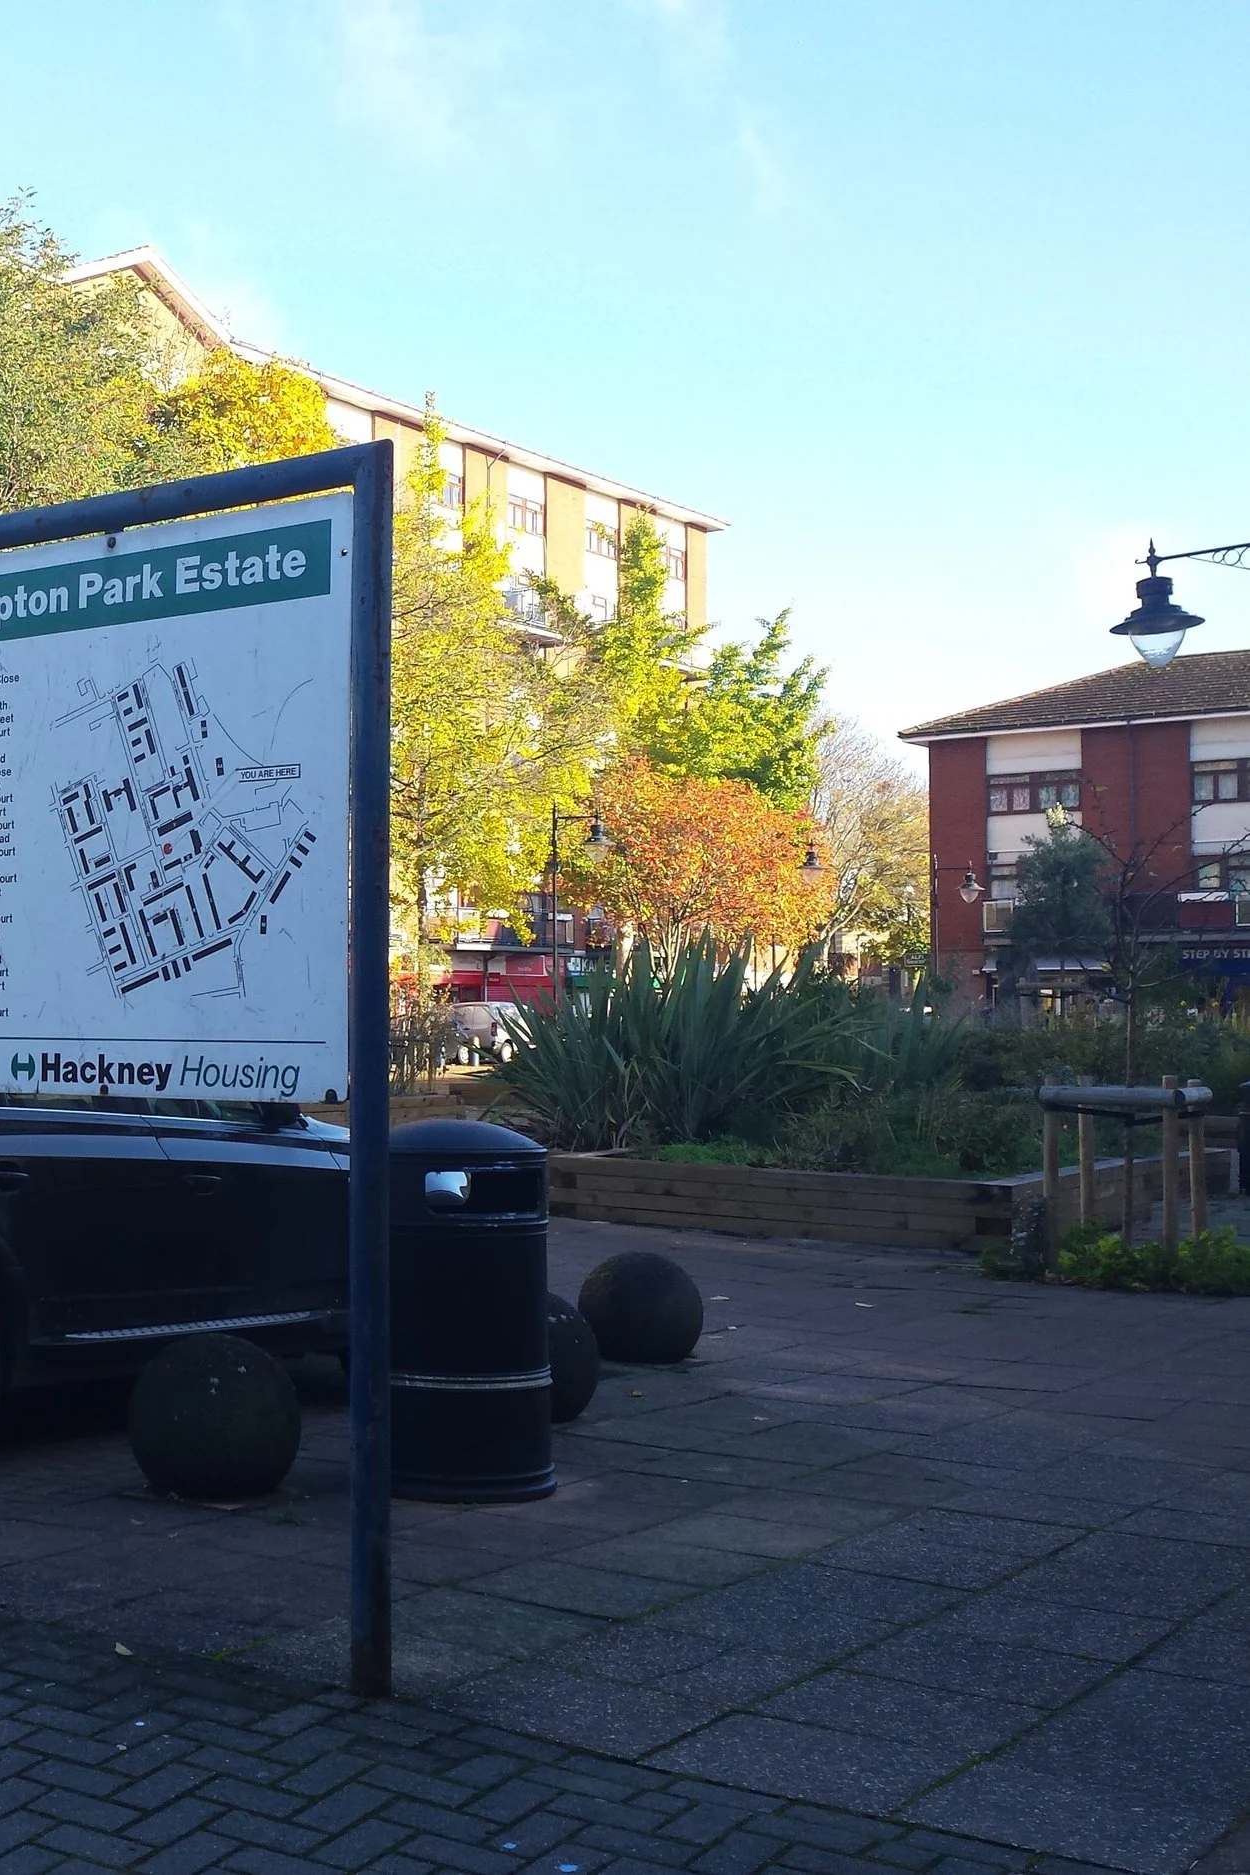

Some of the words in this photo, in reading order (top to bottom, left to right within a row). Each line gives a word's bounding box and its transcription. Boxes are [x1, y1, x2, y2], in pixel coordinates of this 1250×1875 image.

[79, 564, 164, 609] Park
[175, 544, 307, 595] Estate
[241, 771, 257, 779] YOU
[258, 769, 274, 778] ARE
[276, 768, 296, 776] HERE
[1182, 949, 1210, 960] STEP
[41, 1052, 172, 1091] Hackney
[179, 1055, 300, 1097] Housing
